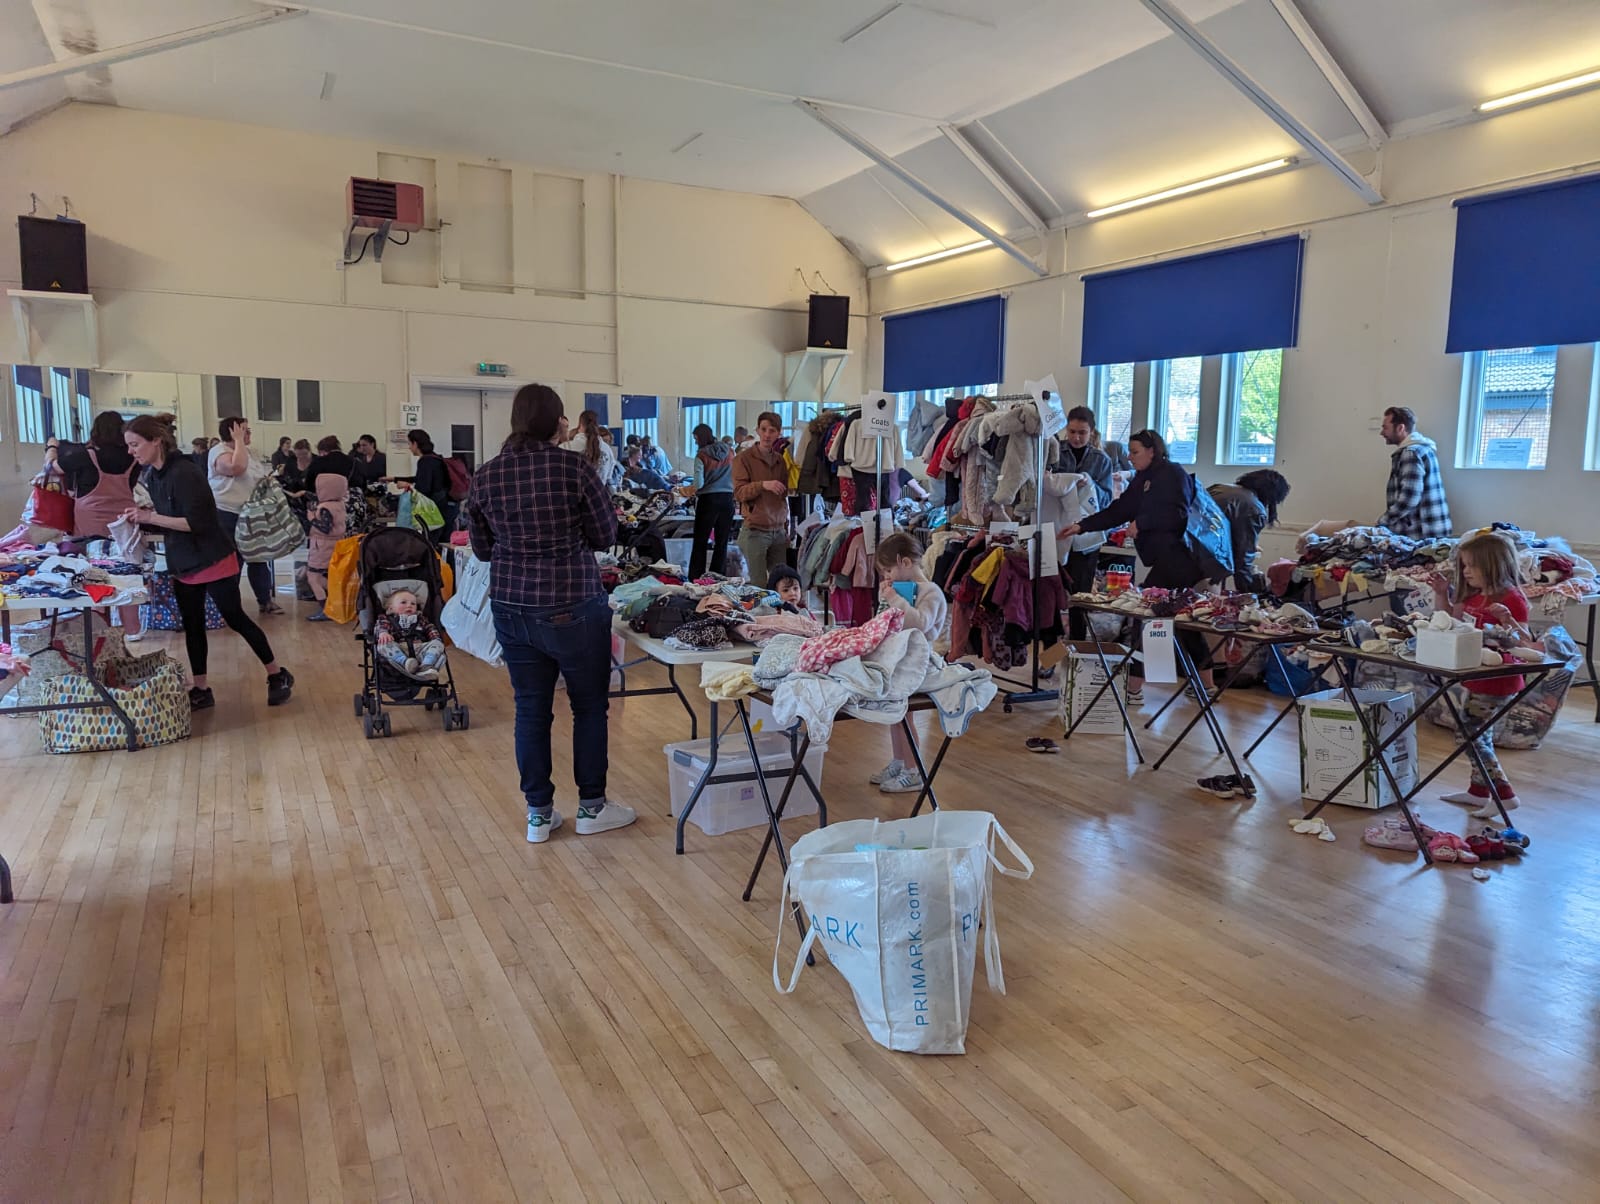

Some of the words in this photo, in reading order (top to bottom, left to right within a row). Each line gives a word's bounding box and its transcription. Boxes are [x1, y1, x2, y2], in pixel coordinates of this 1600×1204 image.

[871, 418, 890, 427] Coats
[1149, 630, 1167, 638] SHOES
[908, 882, 929, 1026] PRIMARK.com
